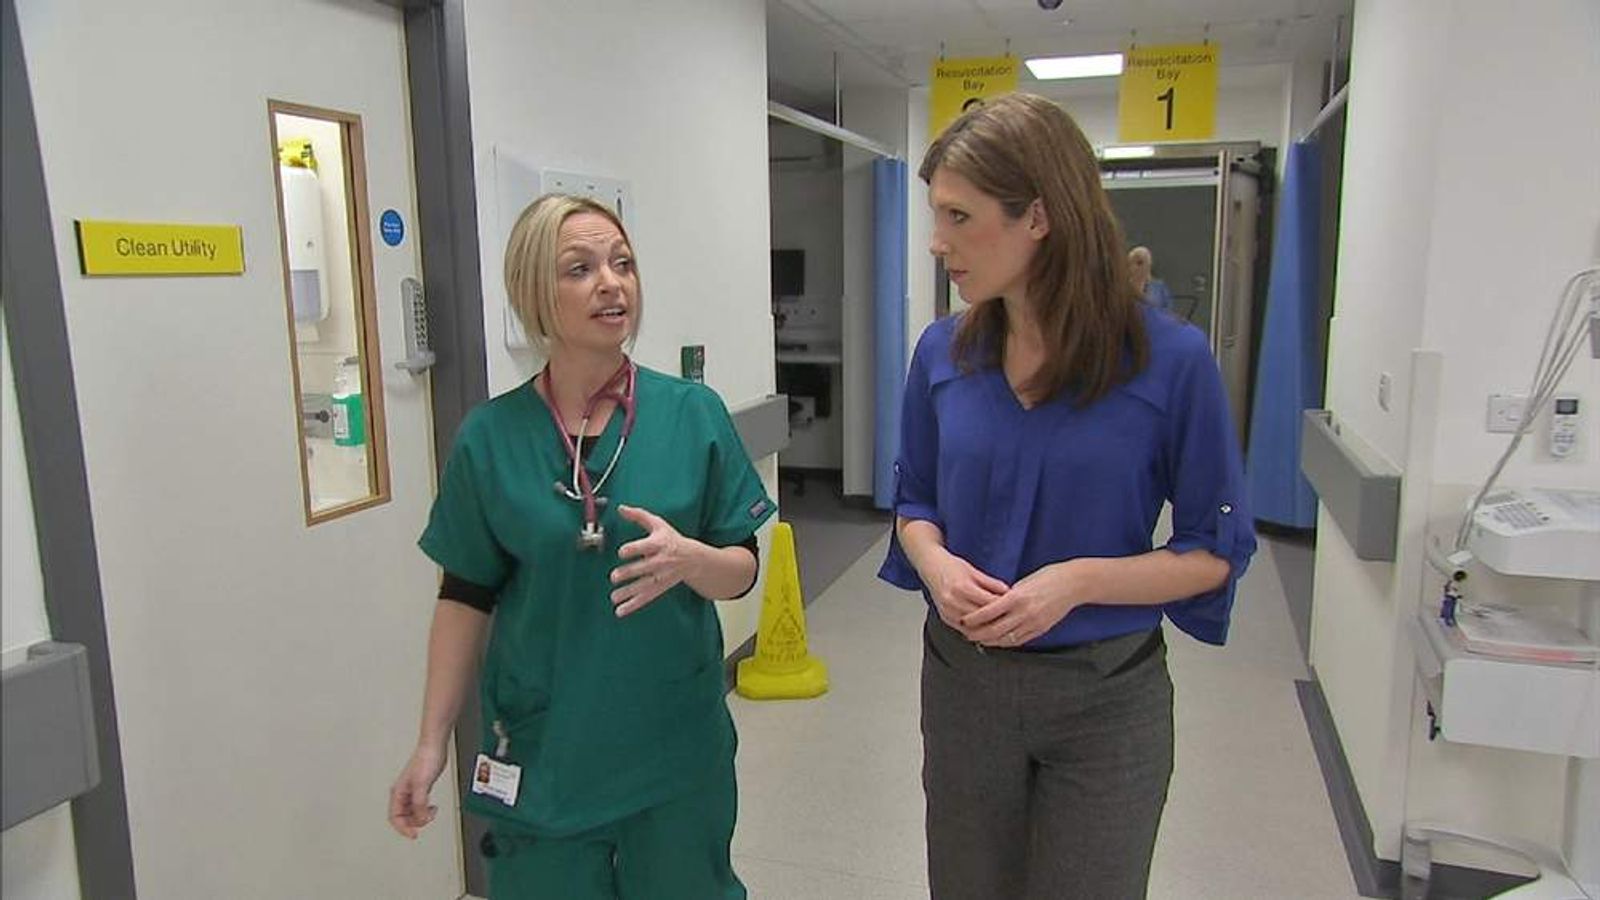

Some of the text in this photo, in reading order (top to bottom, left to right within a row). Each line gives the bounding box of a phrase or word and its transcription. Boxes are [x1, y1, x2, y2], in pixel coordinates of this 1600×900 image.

[935, 65, 1013, 79] Resuscitation
[1157, 68, 1181, 82] Bay
[963, 79, 985, 92] Bay
[1157, 86, 1174, 131] 1
[115, 237, 217, 260] Clean Utility
